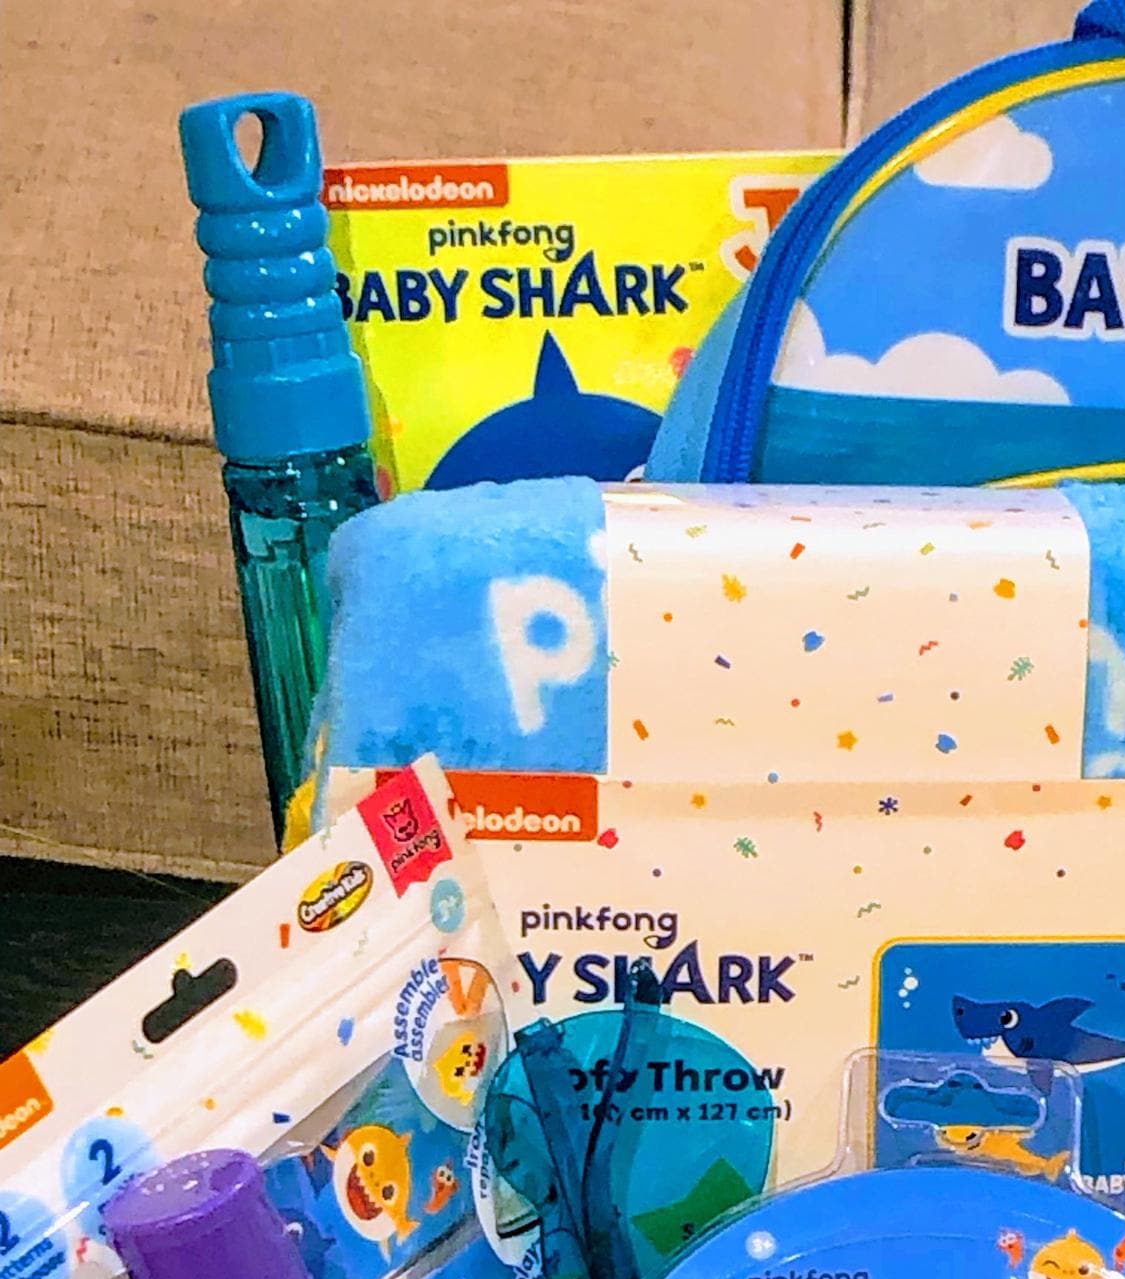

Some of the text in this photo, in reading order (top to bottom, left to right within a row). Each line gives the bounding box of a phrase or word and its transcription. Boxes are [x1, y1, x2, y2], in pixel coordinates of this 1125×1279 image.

[328, 175, 495, 204] nickelodeon
[428, 219, 575, 263] pinkfong
[521, 903, 678, 949] pinkfong
[393, 957, 440, 1059] Assemble
[647, 1059, 786, 1092] Throw
[699, 1104, 738, 1121] 127
[89, 1138, 122, 1187] 2
